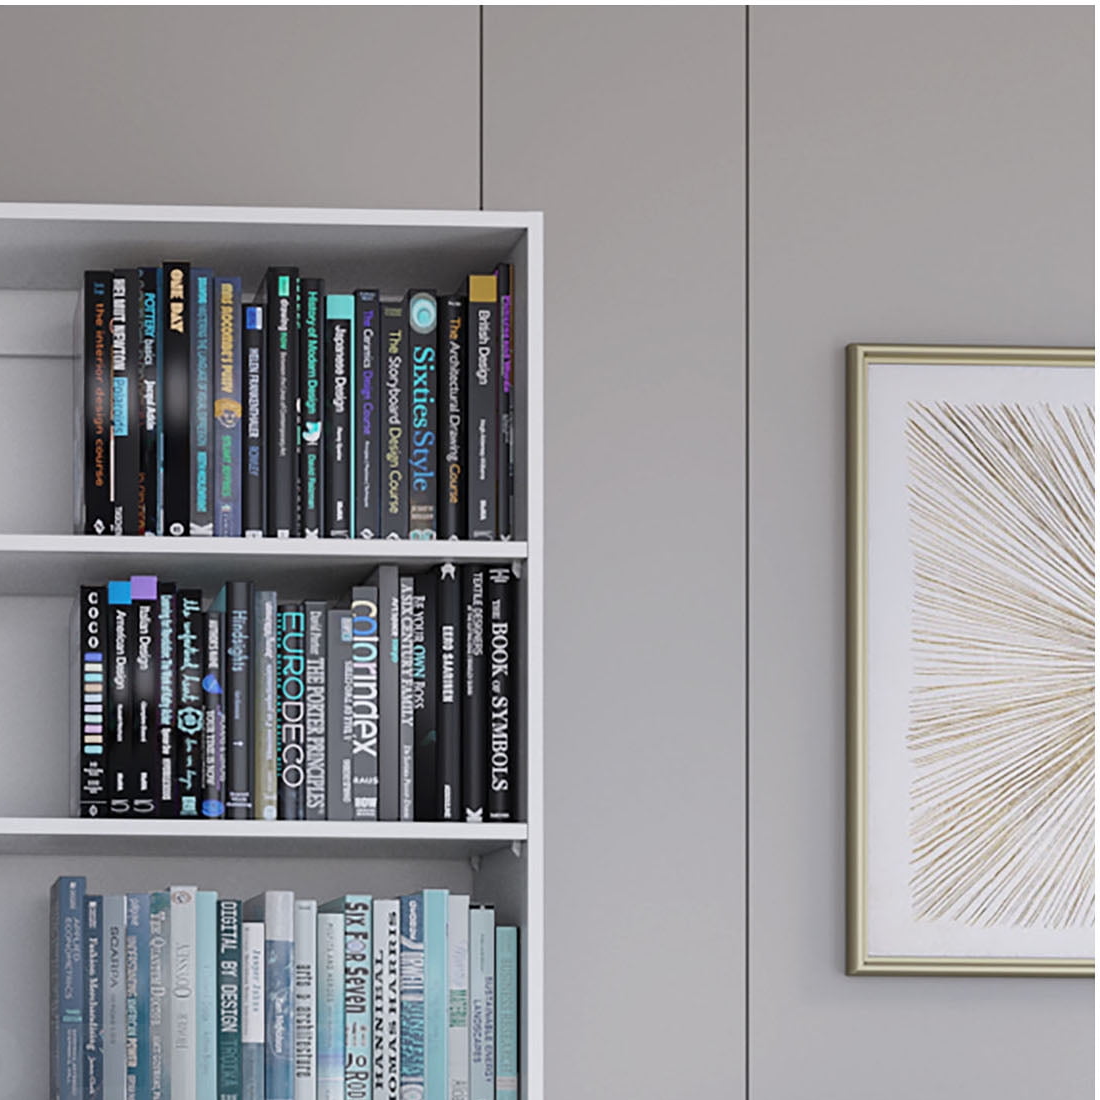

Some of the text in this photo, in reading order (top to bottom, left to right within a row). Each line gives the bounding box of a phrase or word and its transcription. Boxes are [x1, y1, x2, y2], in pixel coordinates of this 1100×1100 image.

[113, 279, 126, 370] HELMUT NEWTON
[144, 293, 155, 365] POTTERY basics
[170, 269, 183, 333] ONE DAY
[306, 291, 318, 414] History of Modern Design
[333, 325, 346, 412] Japanese Design
[360, 310, 374, 435] The Ceramics Design Course
[476, 310, 490, 385] British Design
[93, 303, 105, 486] the interior design course
[386, 330, 401, 513] The Storyboard Design Course
[413, 346, 434, 428] Sixties
[447, 317, 460, 503] The Architectural Drawing Course
[409, 430, 435, 492] Style
[113, 610, 126, 690] American Design
[137, 606, 150, 670] Italian Design
[228, 610, 247, 672] Hindsights
[414, 611, 424, 643] YOUR
[473, 572, 483, 655] TEXTILE DESIGNERS
[491, 622, 508, 677] BOOK
[307, 658, 325, 685] THE
[352, 600, 378, 756] colorindex
[401, 596, 413, 727] SIX CENTURY FAMILY
[414, 645, 424, 678] OWN
[414, 681, 424, 709] BOSS
[442, 626, 453, 702] EERO SAARINEN
[282, 612, 305, 787] EURODECO
[307, 687, 325, 736] PORTER
[491, 696, 508, 791] SYMBOLS
[64, 917, 73, 999] ECONOMETRICS
[88, 938, 98, 976] Fashion
[110, 926, 118, 988] SCARPA
[221, 902, 237, 954] DIGITAL
[388, 912, 397, 1014] HARRIS
[221, 961, 237, 978] BY
[86, 978, 98, 1051] Merchandising
[221, 984, 237, 1032] DESIGN
[296, 964, 311, 1078] arts architecture
[375, 950, 383, 1089] HANNIBAL
[473, 999, 481, 1063] LANDSCAPES
[484, 977, 493, 1083] SUSTAINABLE ENERGY
[221, 1041, 237, 1087] TROIKA
